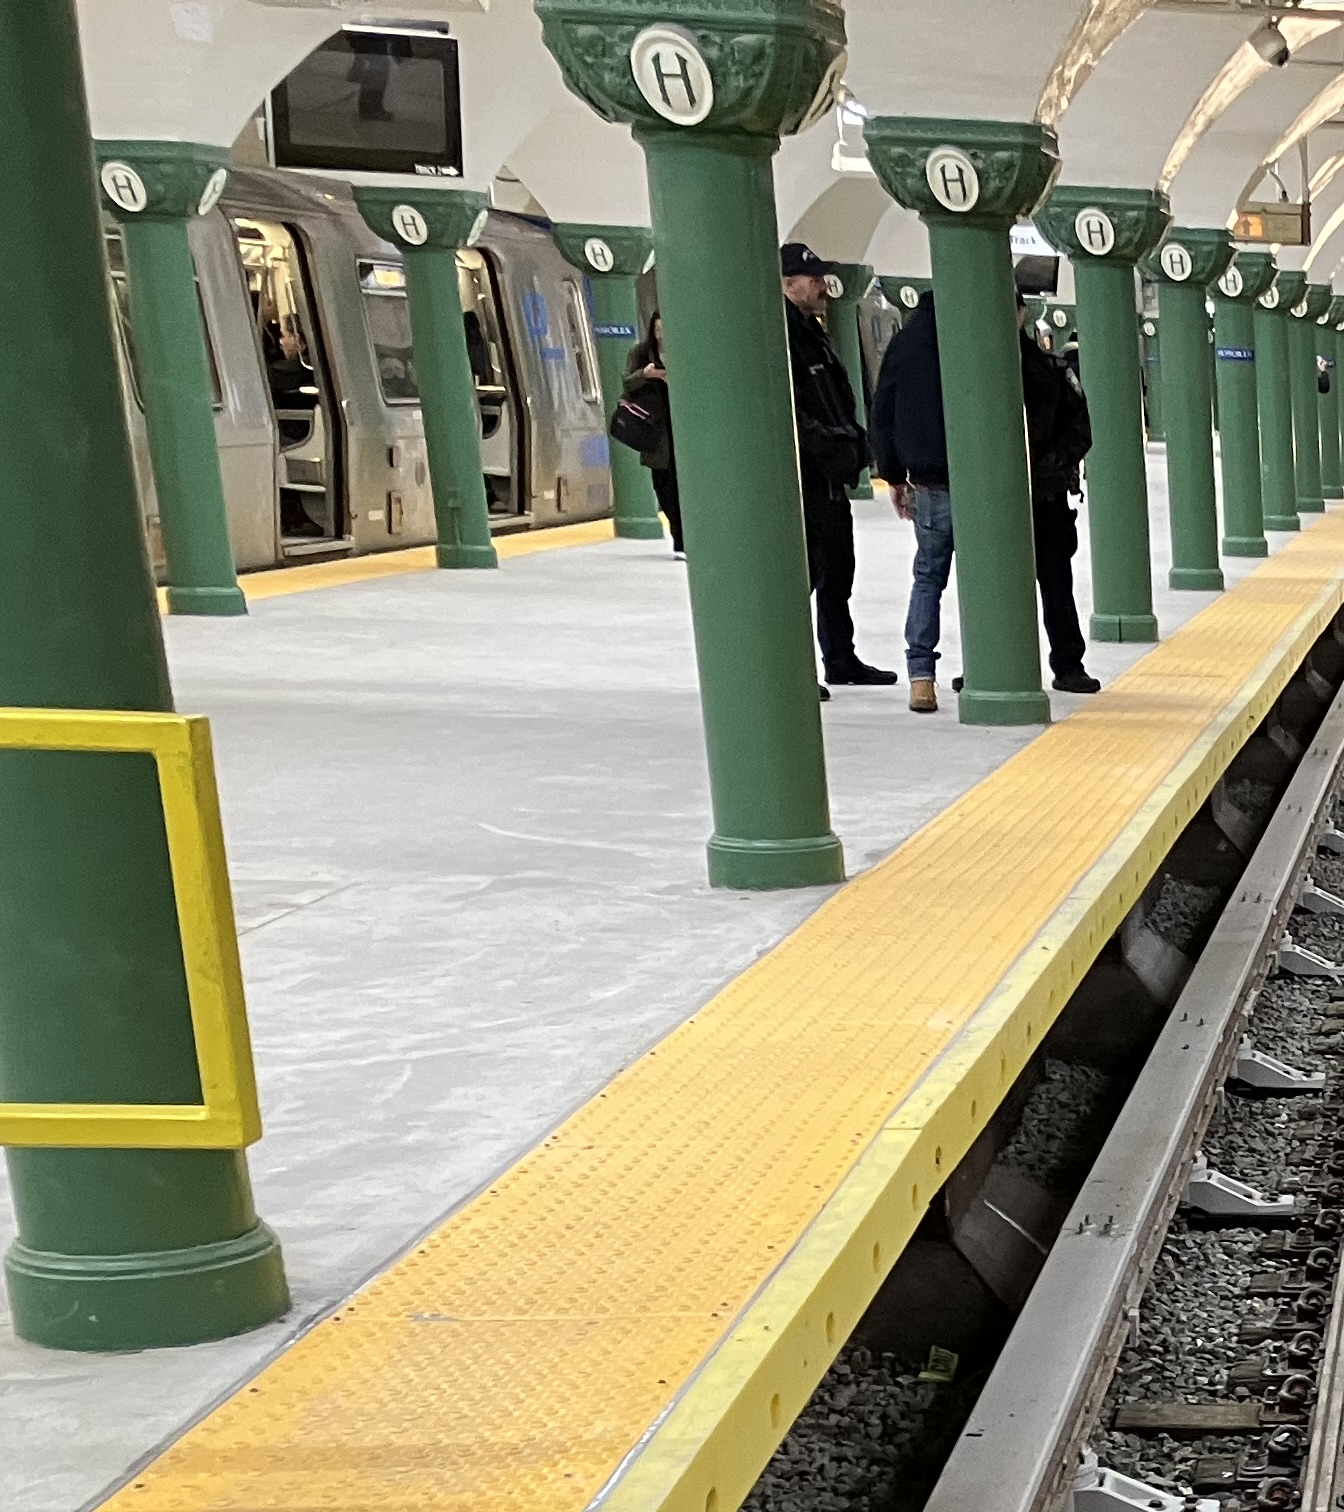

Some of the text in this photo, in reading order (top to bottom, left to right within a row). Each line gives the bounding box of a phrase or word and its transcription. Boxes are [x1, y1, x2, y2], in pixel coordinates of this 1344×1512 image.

[651, 52, 698, 110] H
[111, 174, 138, 204] H
[939, 163, 967, 203] H
[400, 214, 422, 236] H
[1086, 219, 1106, 247] H
[591, 244, 608, 266] H
[1169, 253, 1185, 274] H
[1224, 273, 1238, 291] H
